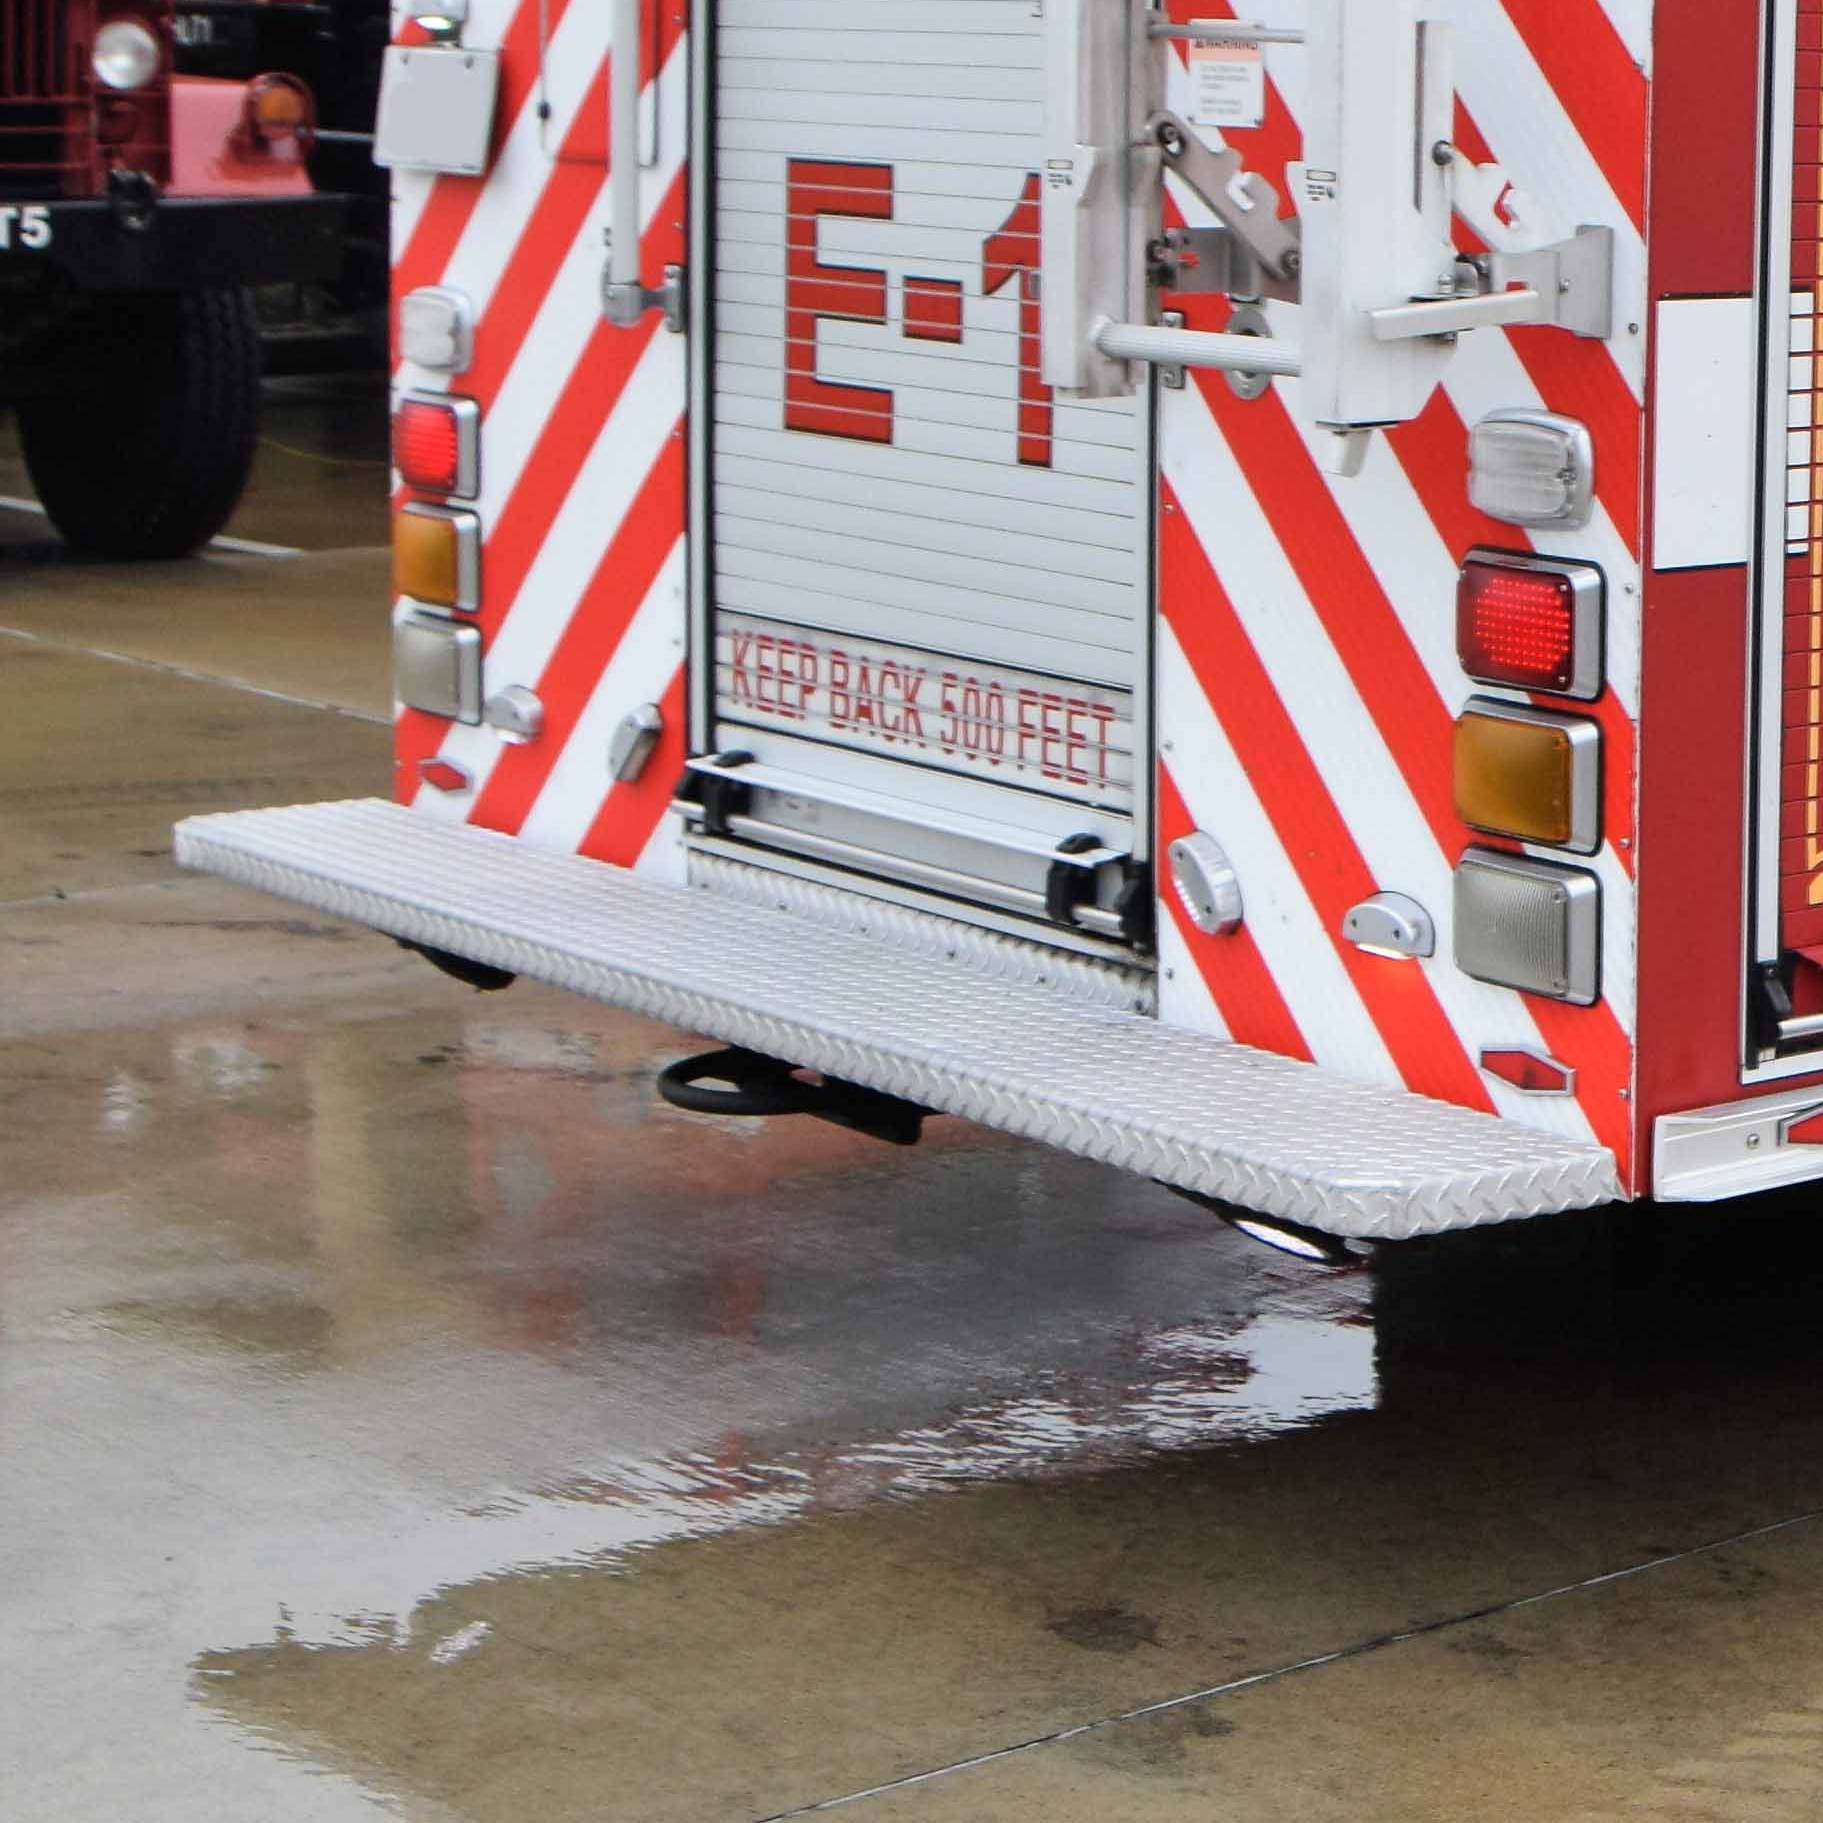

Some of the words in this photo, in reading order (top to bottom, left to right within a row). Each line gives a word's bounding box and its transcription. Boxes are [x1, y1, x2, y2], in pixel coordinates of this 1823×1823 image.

[784, 156, 1053, 467] E-1
[731, 628, 819, 720] KEEP
[829, 649, 926, 750] BACK
[940, 671, 1004, 766] 500
[1017, 688, 1117, 790] FEET
